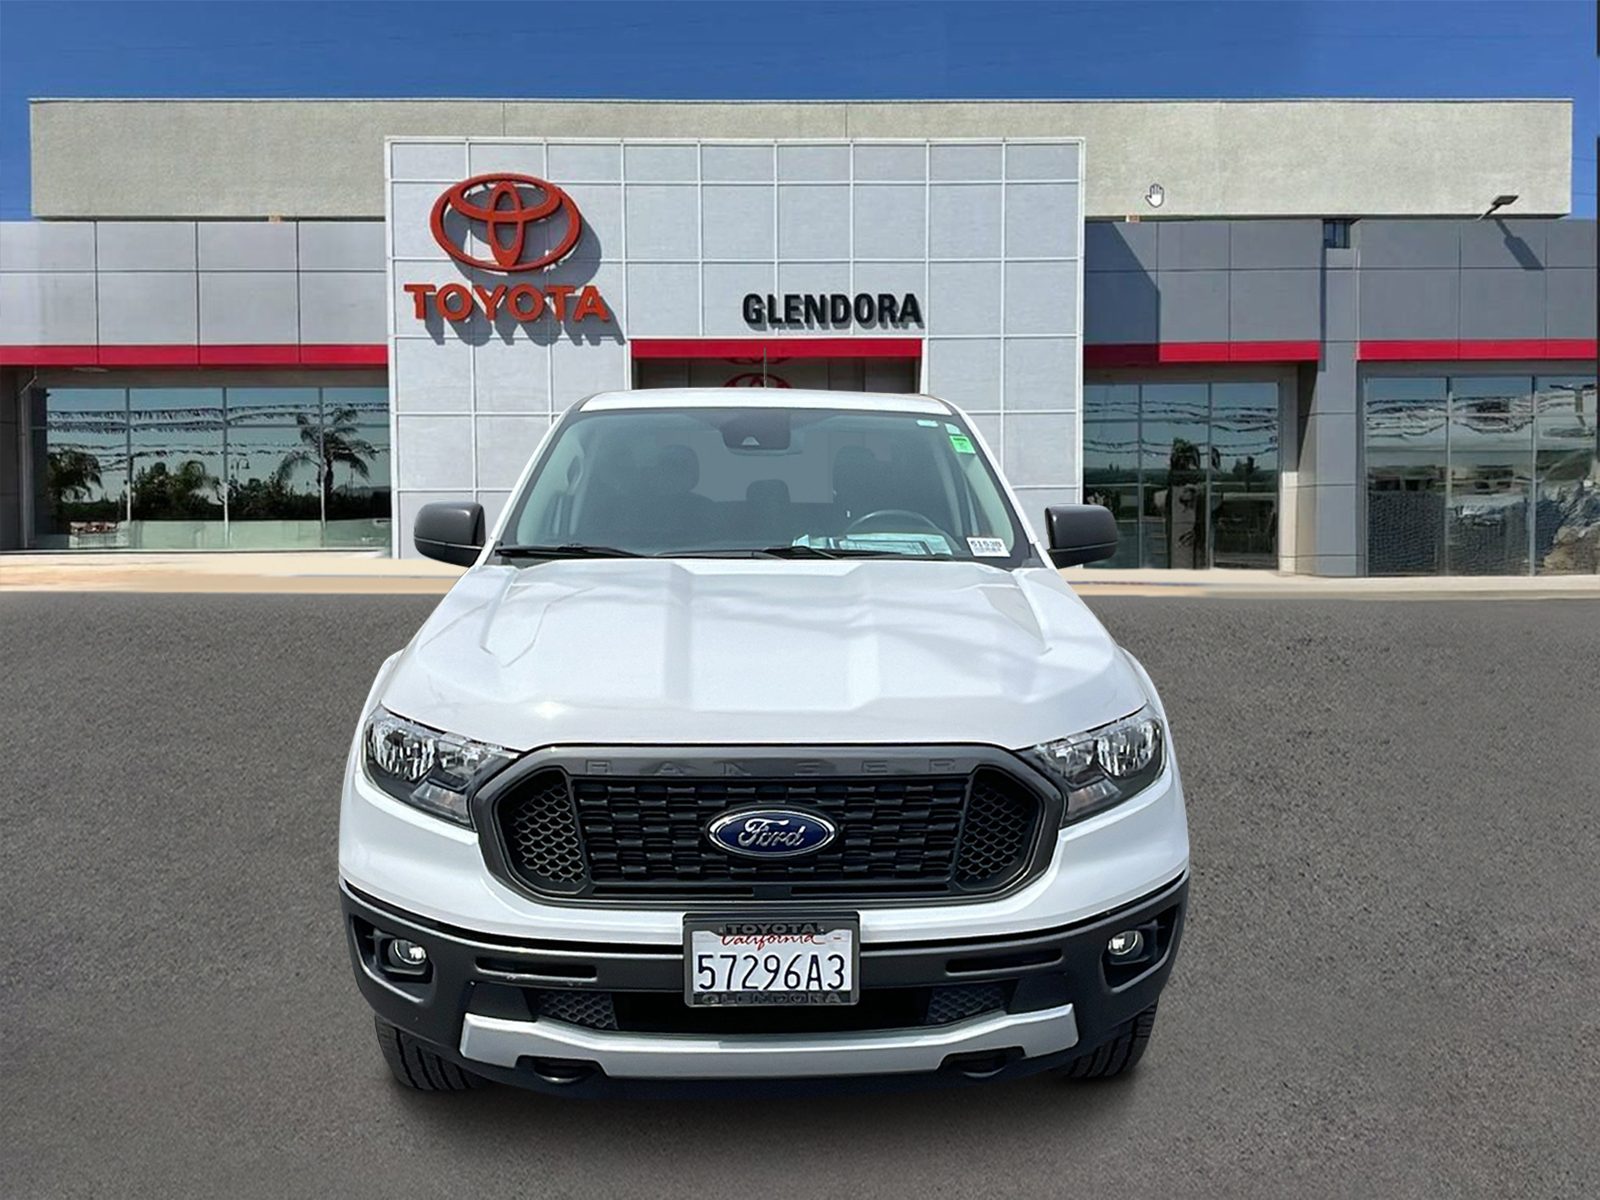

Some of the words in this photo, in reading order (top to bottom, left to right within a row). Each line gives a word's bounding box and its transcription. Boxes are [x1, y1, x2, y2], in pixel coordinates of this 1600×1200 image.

[404, 284, 610, 322] TOYOTA
[742, 293, 921, 325] GLENDORA
[738, 818, 807, 848] Ford
[728, 924, 816, 935] TOYOTA
[698, 954, 844, 990] 57296A3
